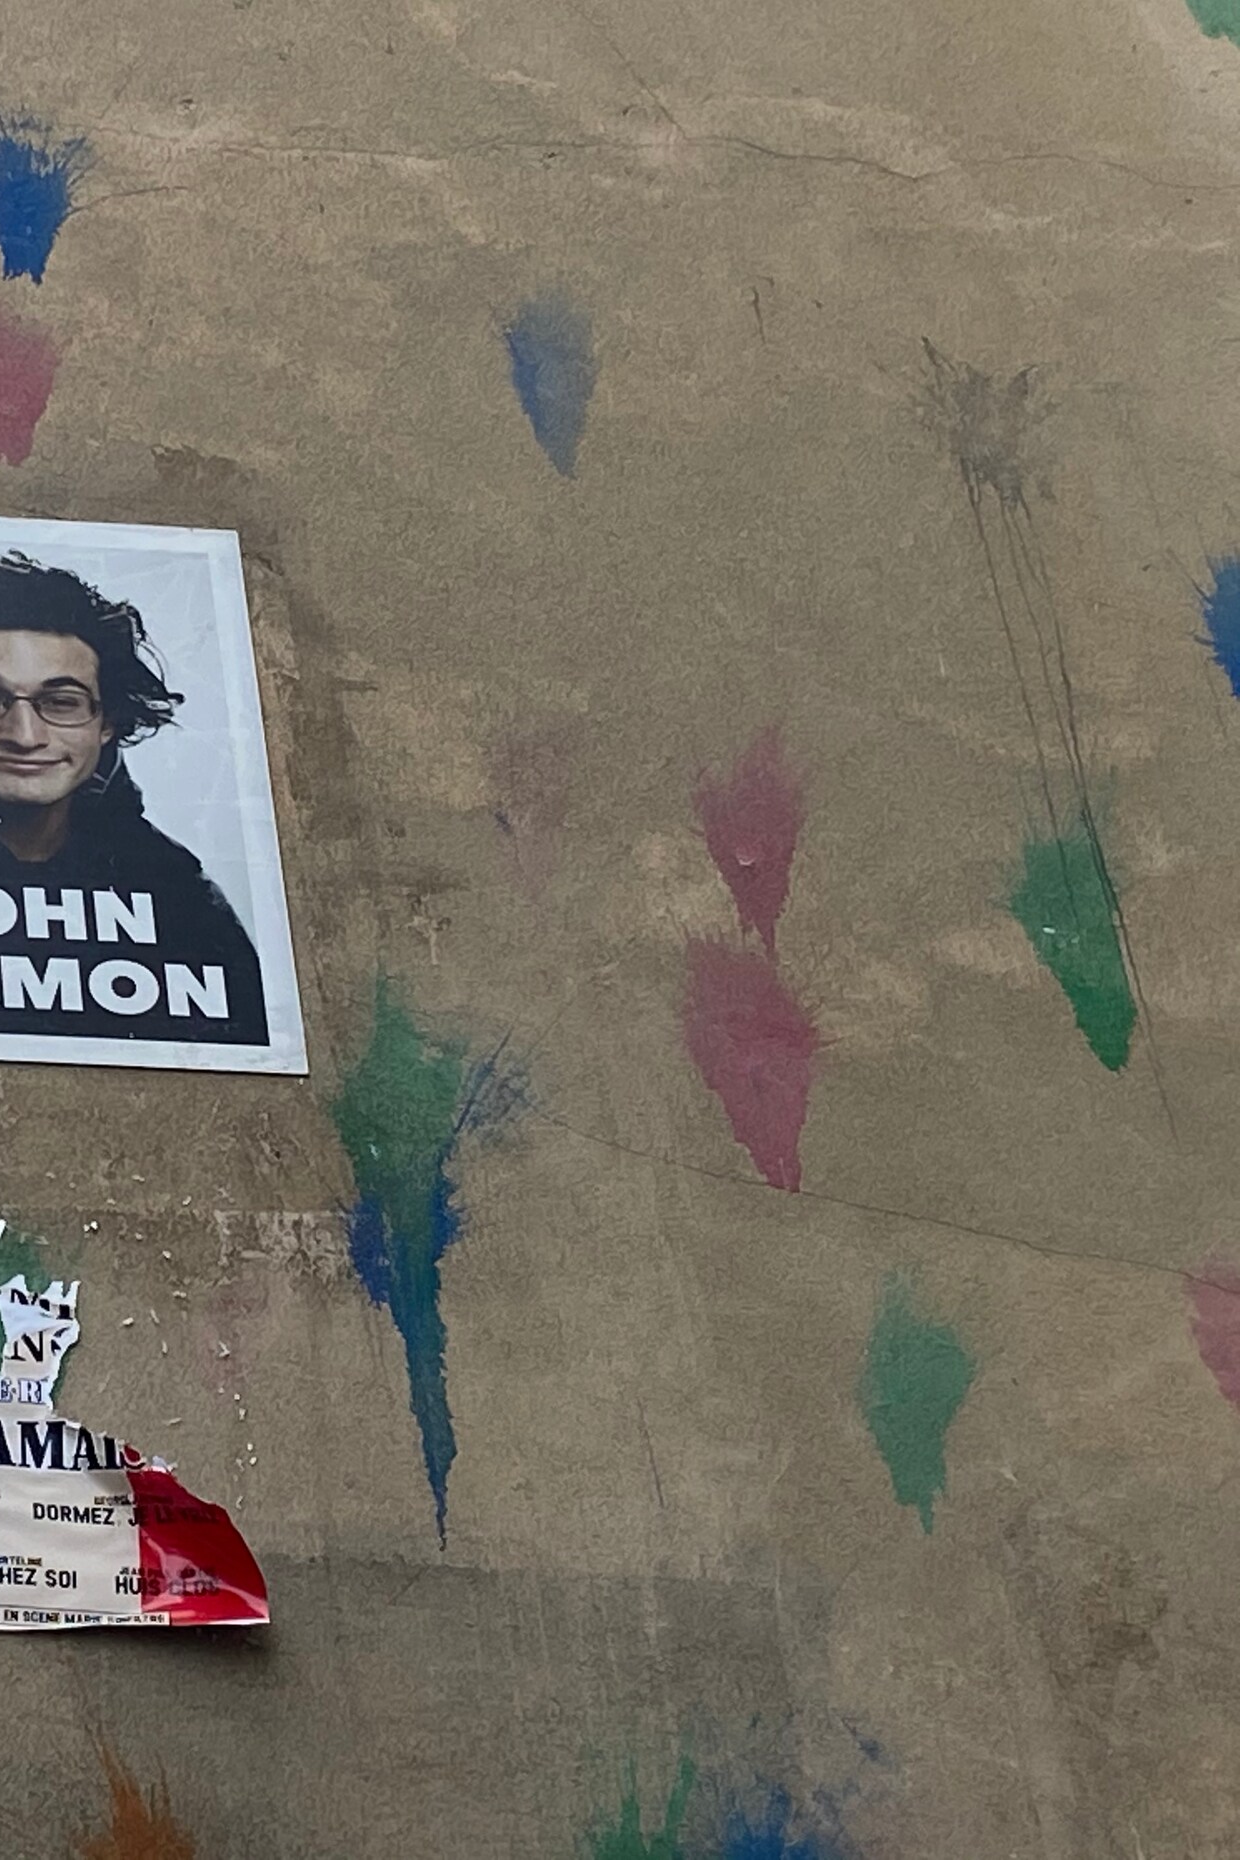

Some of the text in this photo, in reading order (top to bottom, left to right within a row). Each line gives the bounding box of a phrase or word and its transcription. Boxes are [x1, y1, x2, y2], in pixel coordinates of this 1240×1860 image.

[45, 1570, 77, 1589] SOI
[115, 1575, 162, 1597] HUIS
[3, 1609, 19, 1622] EN
